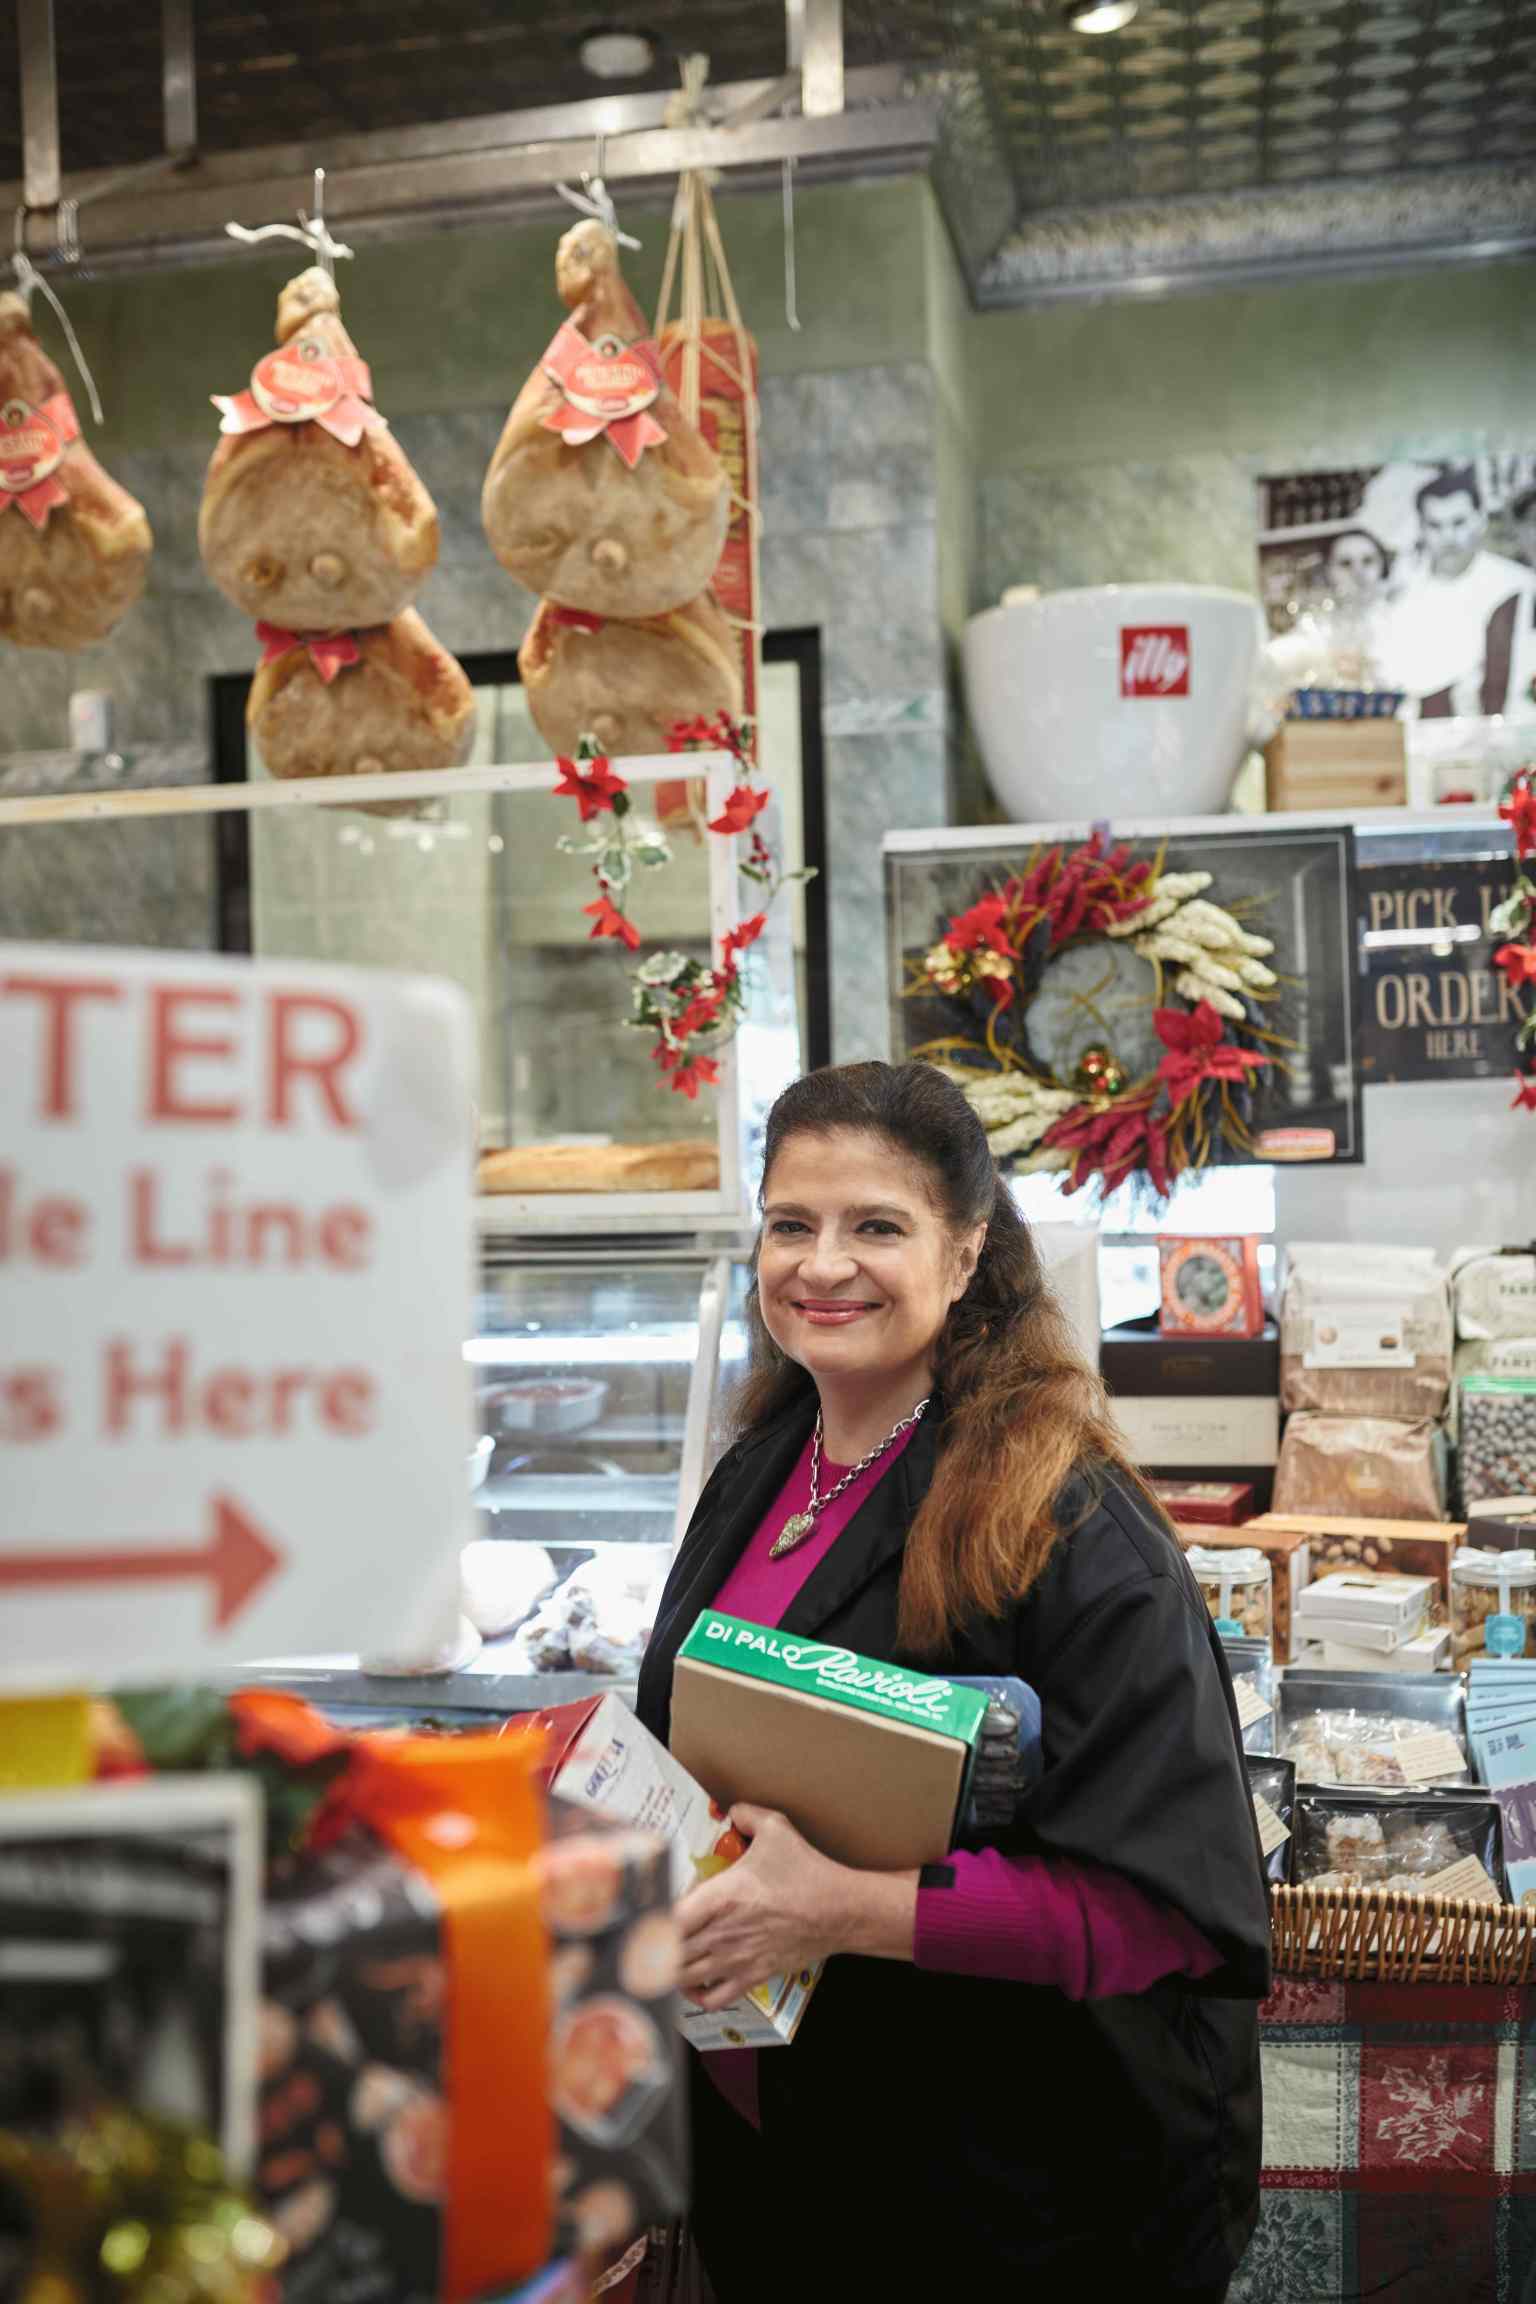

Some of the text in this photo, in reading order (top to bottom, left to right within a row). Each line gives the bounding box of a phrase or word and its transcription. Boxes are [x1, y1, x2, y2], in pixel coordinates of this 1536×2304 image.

[1124, 632, 1187, 692] illy
[1368, 887, 1458, 943] PICK
[0, 973, 367, 1131] TER
[127, 1165, 374, 1271] Line
[102, 1337, 378, 1442] Here
[705, 1621, 733, 1642] DI
[734, 1629, 802, 1662] PALO
[788, 1644, 953, 1712] Ravioli
